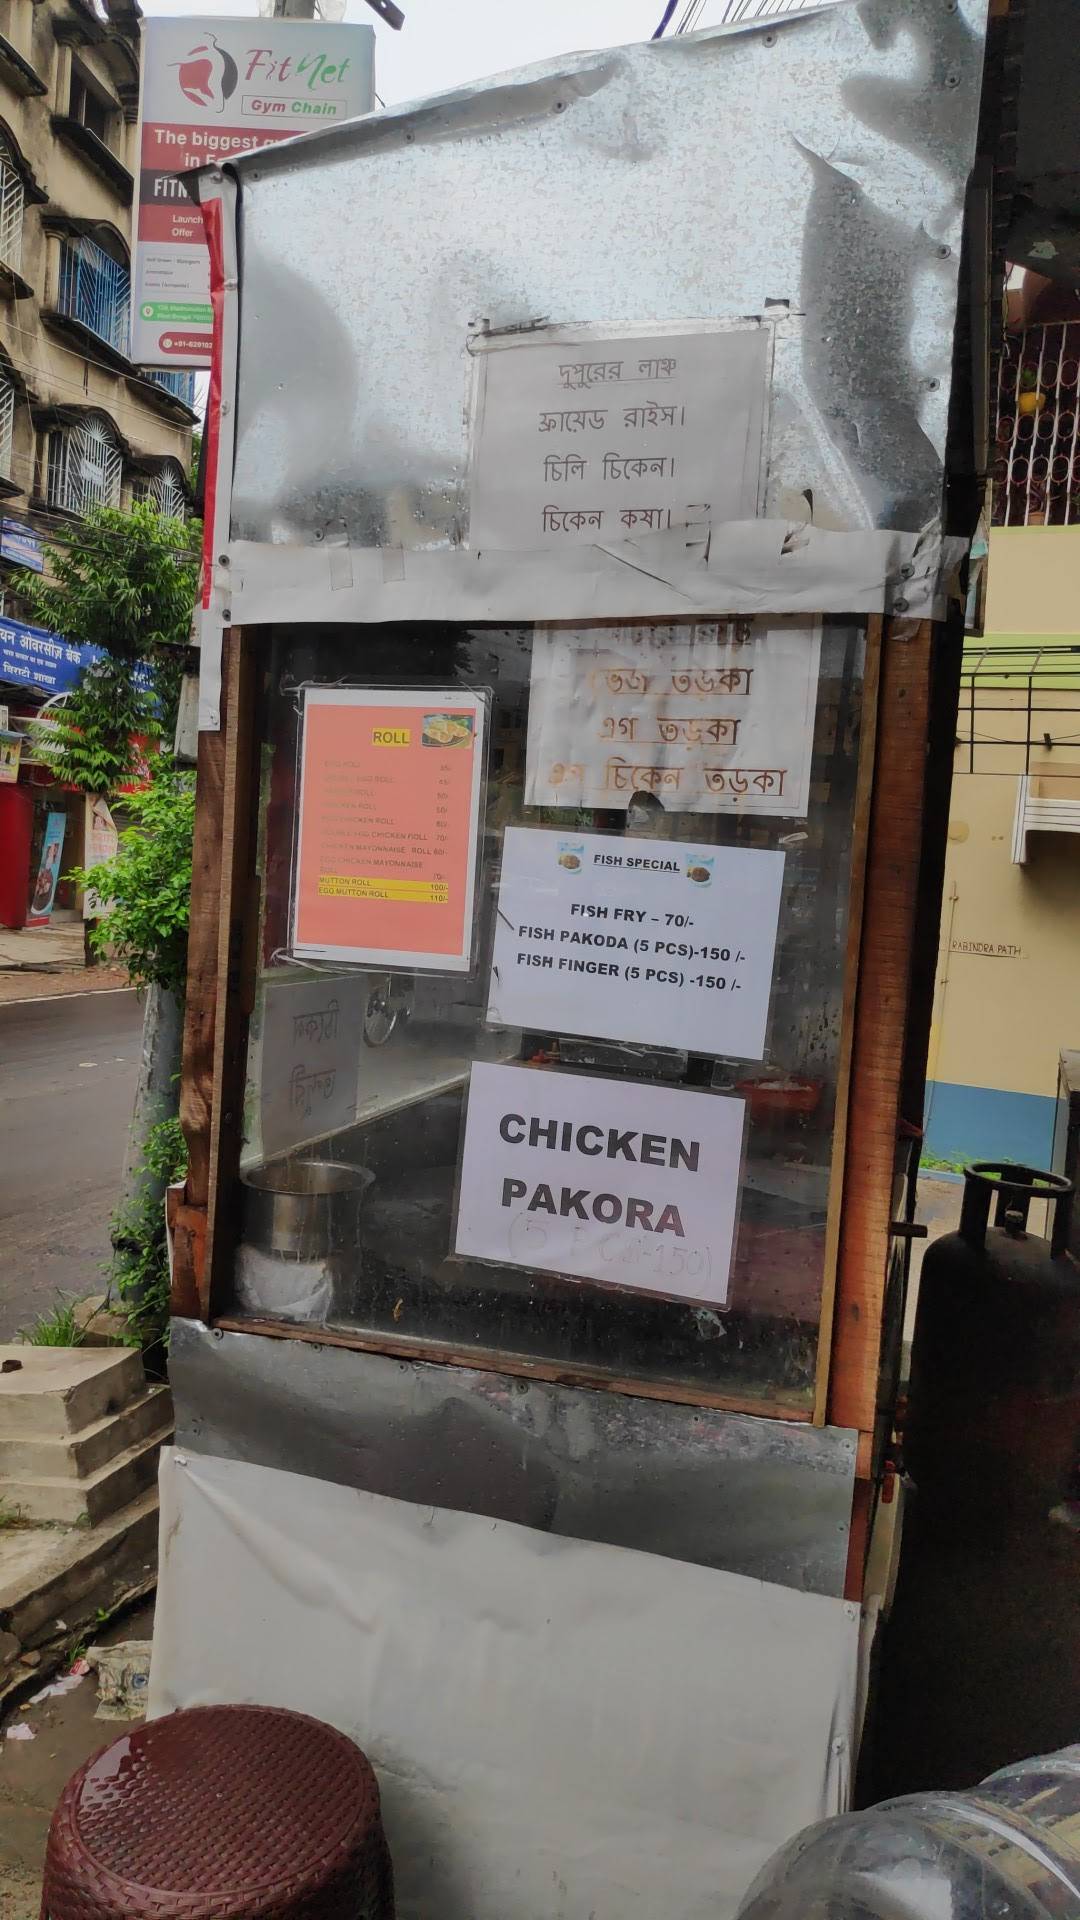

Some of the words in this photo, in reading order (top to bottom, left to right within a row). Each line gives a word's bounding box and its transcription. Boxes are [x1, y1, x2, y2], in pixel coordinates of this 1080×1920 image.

[251, 100, 286, 114] Gym
[291, 101, 337, 115] Chain
[155, 129, 187, 145] The
[192, 130, 258, 150] biggest
[184, 153, 200, 168] in
[172, 215, 204, 225] Launch
[172, 228, 194, 237] Offer
[558, 359, 624, 390] দুপুরের
[543, 454, 587, 482] চিলি
[543, 505, 603, 532] চিকেন
[373, 730, 410, 745] ROLL
[371, 831, 407, 840] CHICKEN
[408, 833, 428, 841] ROLL
[411, 847, 432, 856] ROLL
[593, 854, 623, 868] FISH
[626, 857, 681, 872] SPECIAL
[319, 877, 350, 886] MUTTON
[351, 878, 372, 888] ROLL
[335, 888, 367, 897] MUTTON
[368, 890, 389, 899] ROLL
[570, 903, 608, 919] FISH
[614, 908, 646, 923] FRY
[665, 913, 694, 928] 70/-
[518, 925, 555, 941] FISH
[559, 930, 628, 950] PAKODA
[634, 938, 649, 954] (5
[997, 944, 1021, 956] PATH
[517, 952, 552, 968] FISH
[558, 958, 620, 977] FINGER
[624, 966, 640, 981] (5
[646, 969, 685, 987] PCS)
[499, 1113, 700, 1172] CHICKEN
[501, 1177, 686, 1237] PAKORA
